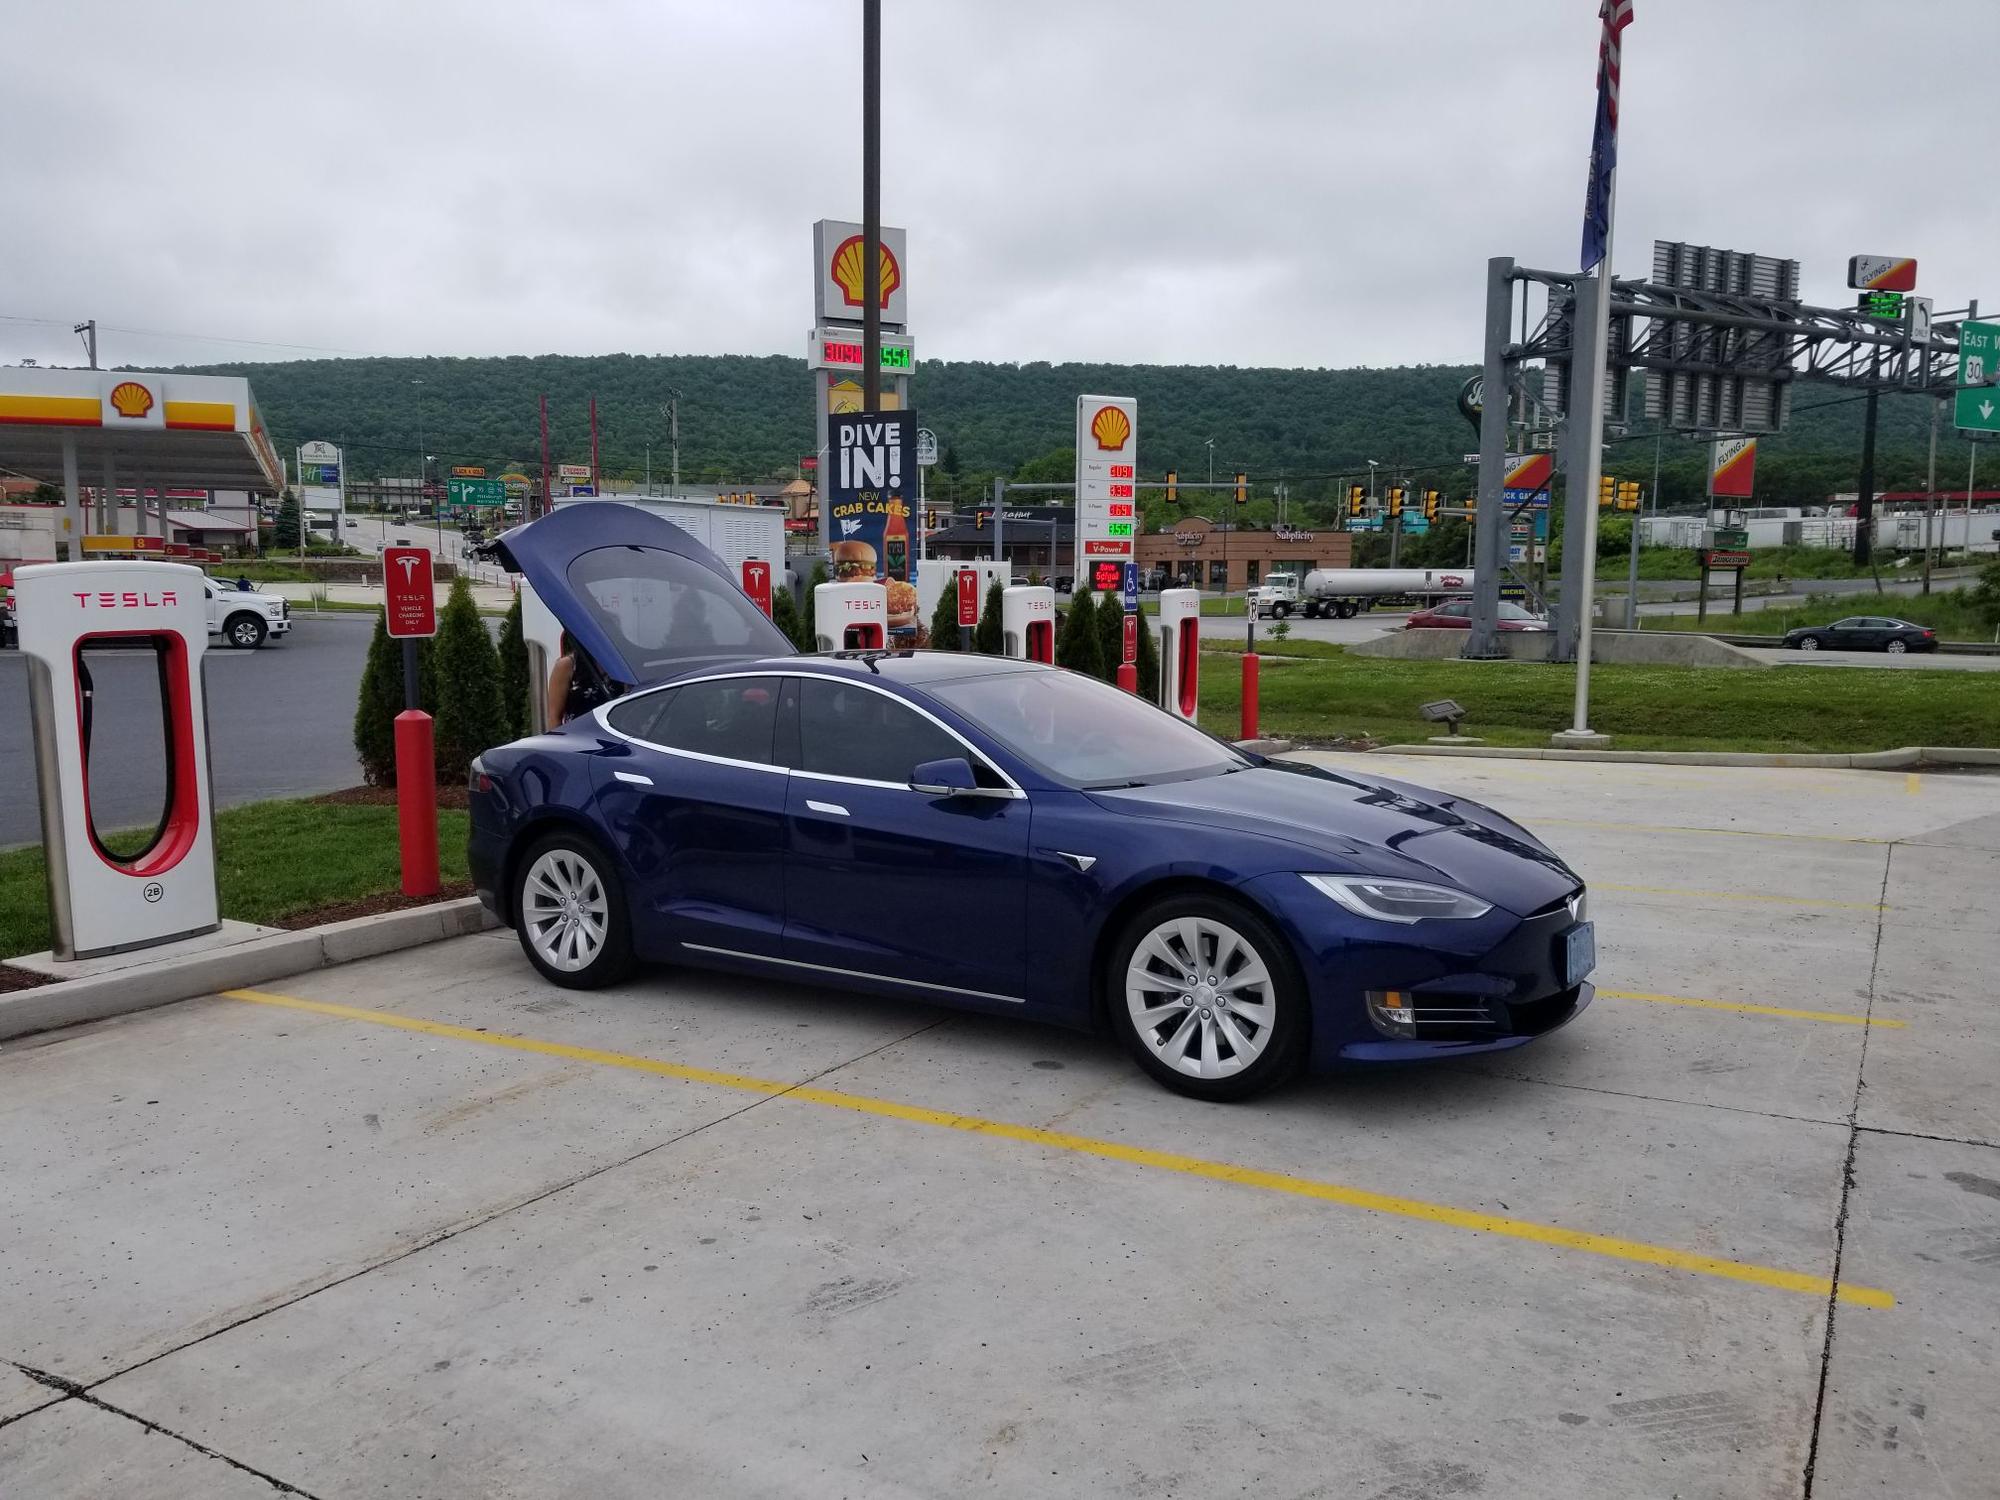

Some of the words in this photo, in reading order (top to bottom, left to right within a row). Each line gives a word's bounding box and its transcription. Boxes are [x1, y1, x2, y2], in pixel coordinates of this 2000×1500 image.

[1862, 264, 1887, 284] FLYING
[1963, 330, 1989, 348] EAST
[1967, 361, 1981, 379] 30
[840, 422, 901, 447] DIVE
[1717, 442, 1741, 466] FLYING
[840, 446, 901, 489] IN!
[859, 491, 880, 500] NEW
[833, 502, 864, 518] CRAB
[866, 501, 911, 517] CAKES
[137, 538, 145, 549] 8
[1276, 530, 1314, 543] Subplicity
[166, 546, 174, 555] 6
[1093, 545, 1122, 553] V-Power
[72, 592, 177, 609] TESLA
[844, 600, 881, 610] TESLA
[147, 887, 161, 897] 2B
